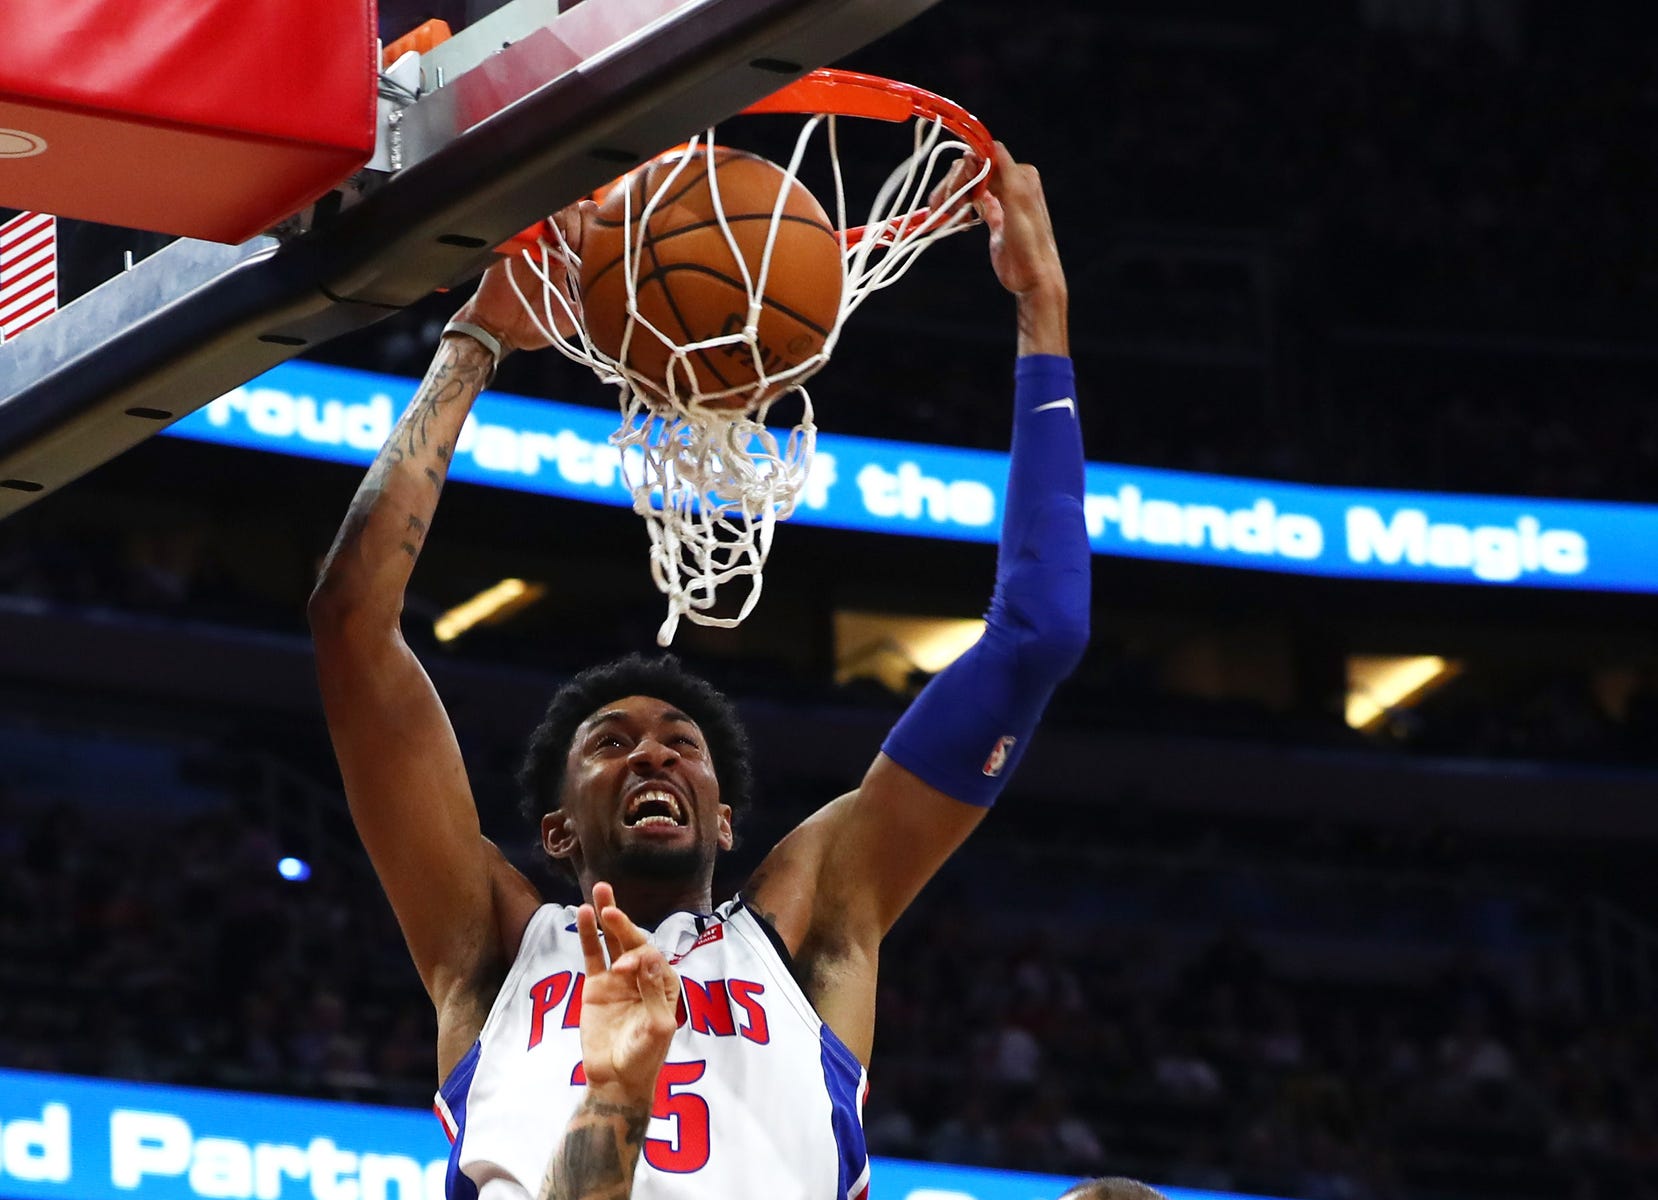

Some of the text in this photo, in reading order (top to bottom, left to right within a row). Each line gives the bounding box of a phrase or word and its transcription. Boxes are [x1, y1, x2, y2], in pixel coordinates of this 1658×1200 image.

[205, 385, 393, 450] roud
[857, 462, 995, 526] the
[1084, 485, 1323, 560] rlando
[1346, 506, 1587, 581] Magic
[527, 970, 770, 1052] PINS
[570, 1059, 711, 1174] 5
